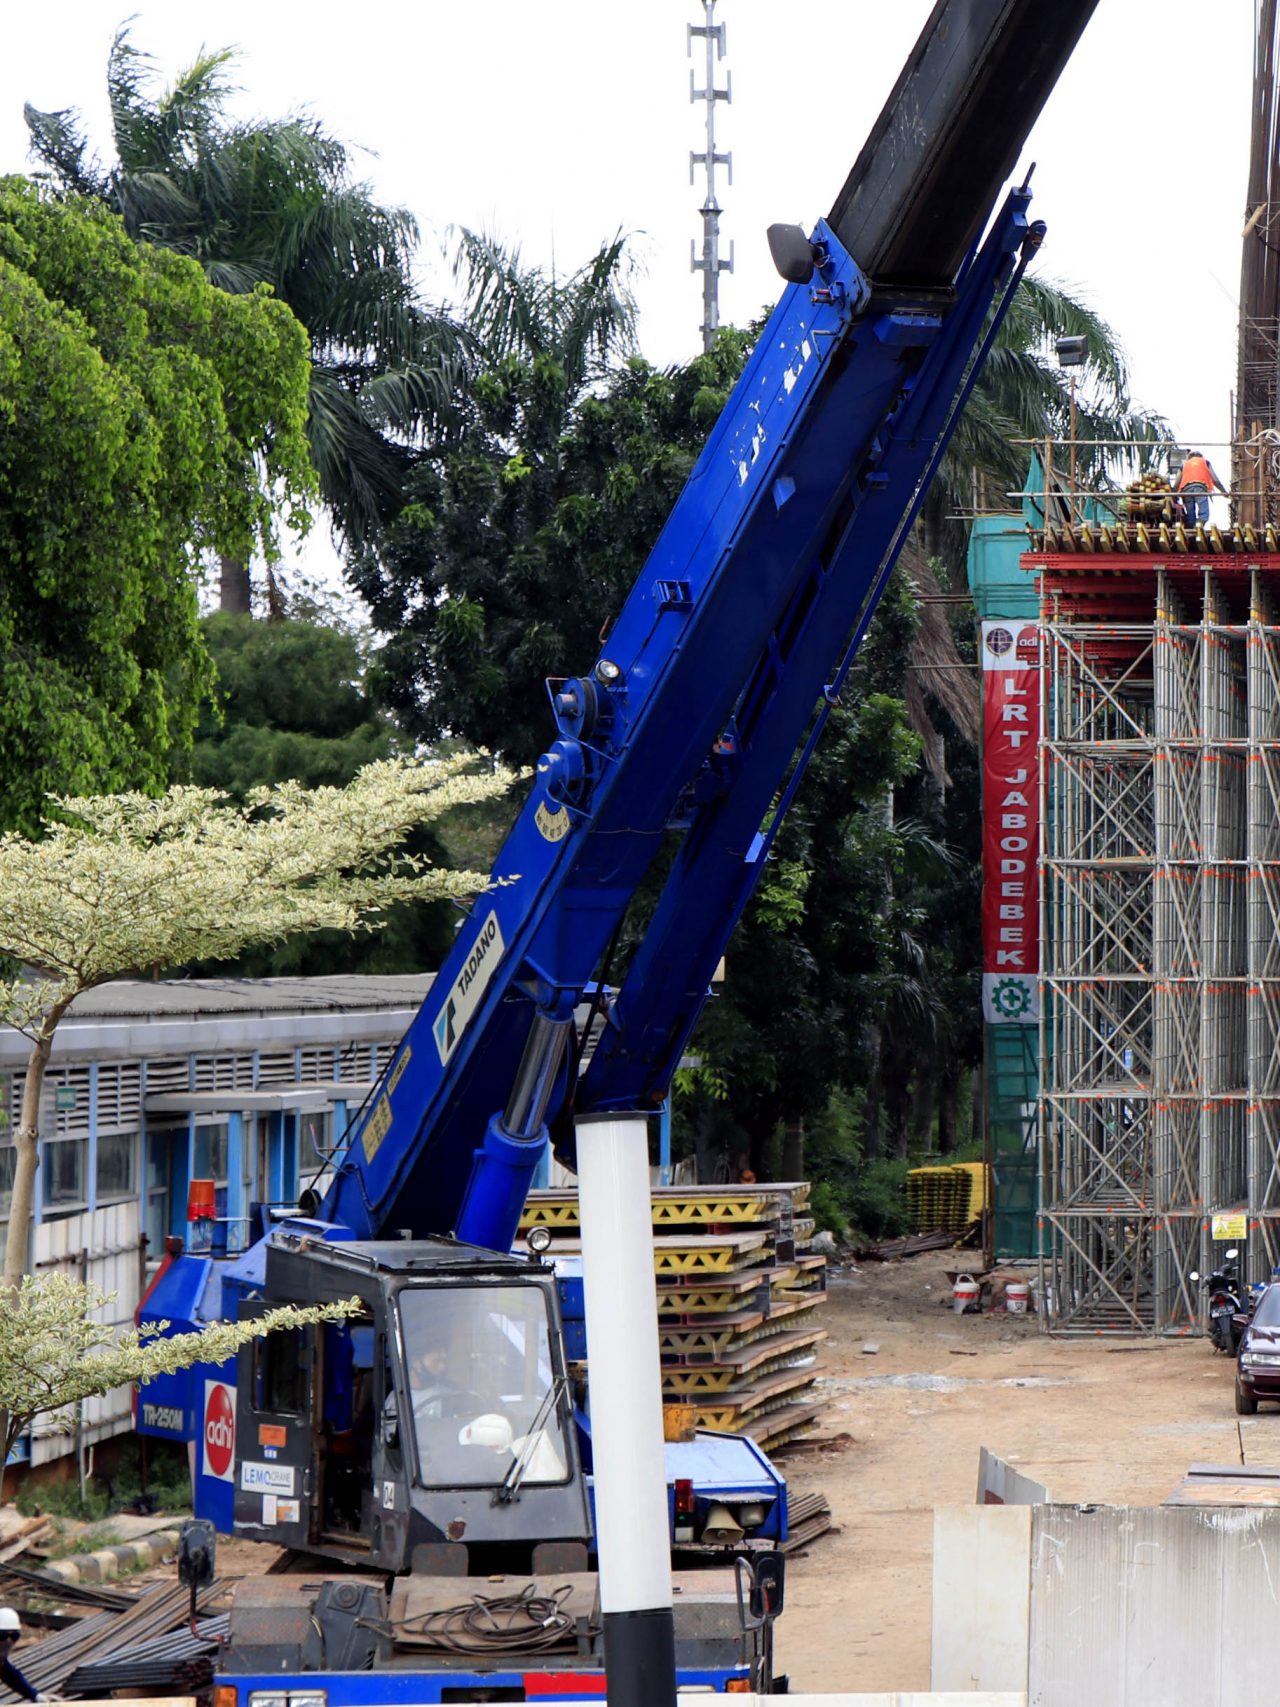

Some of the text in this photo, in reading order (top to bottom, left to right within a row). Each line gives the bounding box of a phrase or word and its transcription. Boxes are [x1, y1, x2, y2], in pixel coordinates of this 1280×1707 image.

[1001, 678, 1028, 748] LRT
[996, 769, 1028, 966] JABODEBEK
[457, 919, 496, 996] TADANO
[142, 1404, 184, 1431] TR-250M
[207, 1416, 232, 1449] adhi
